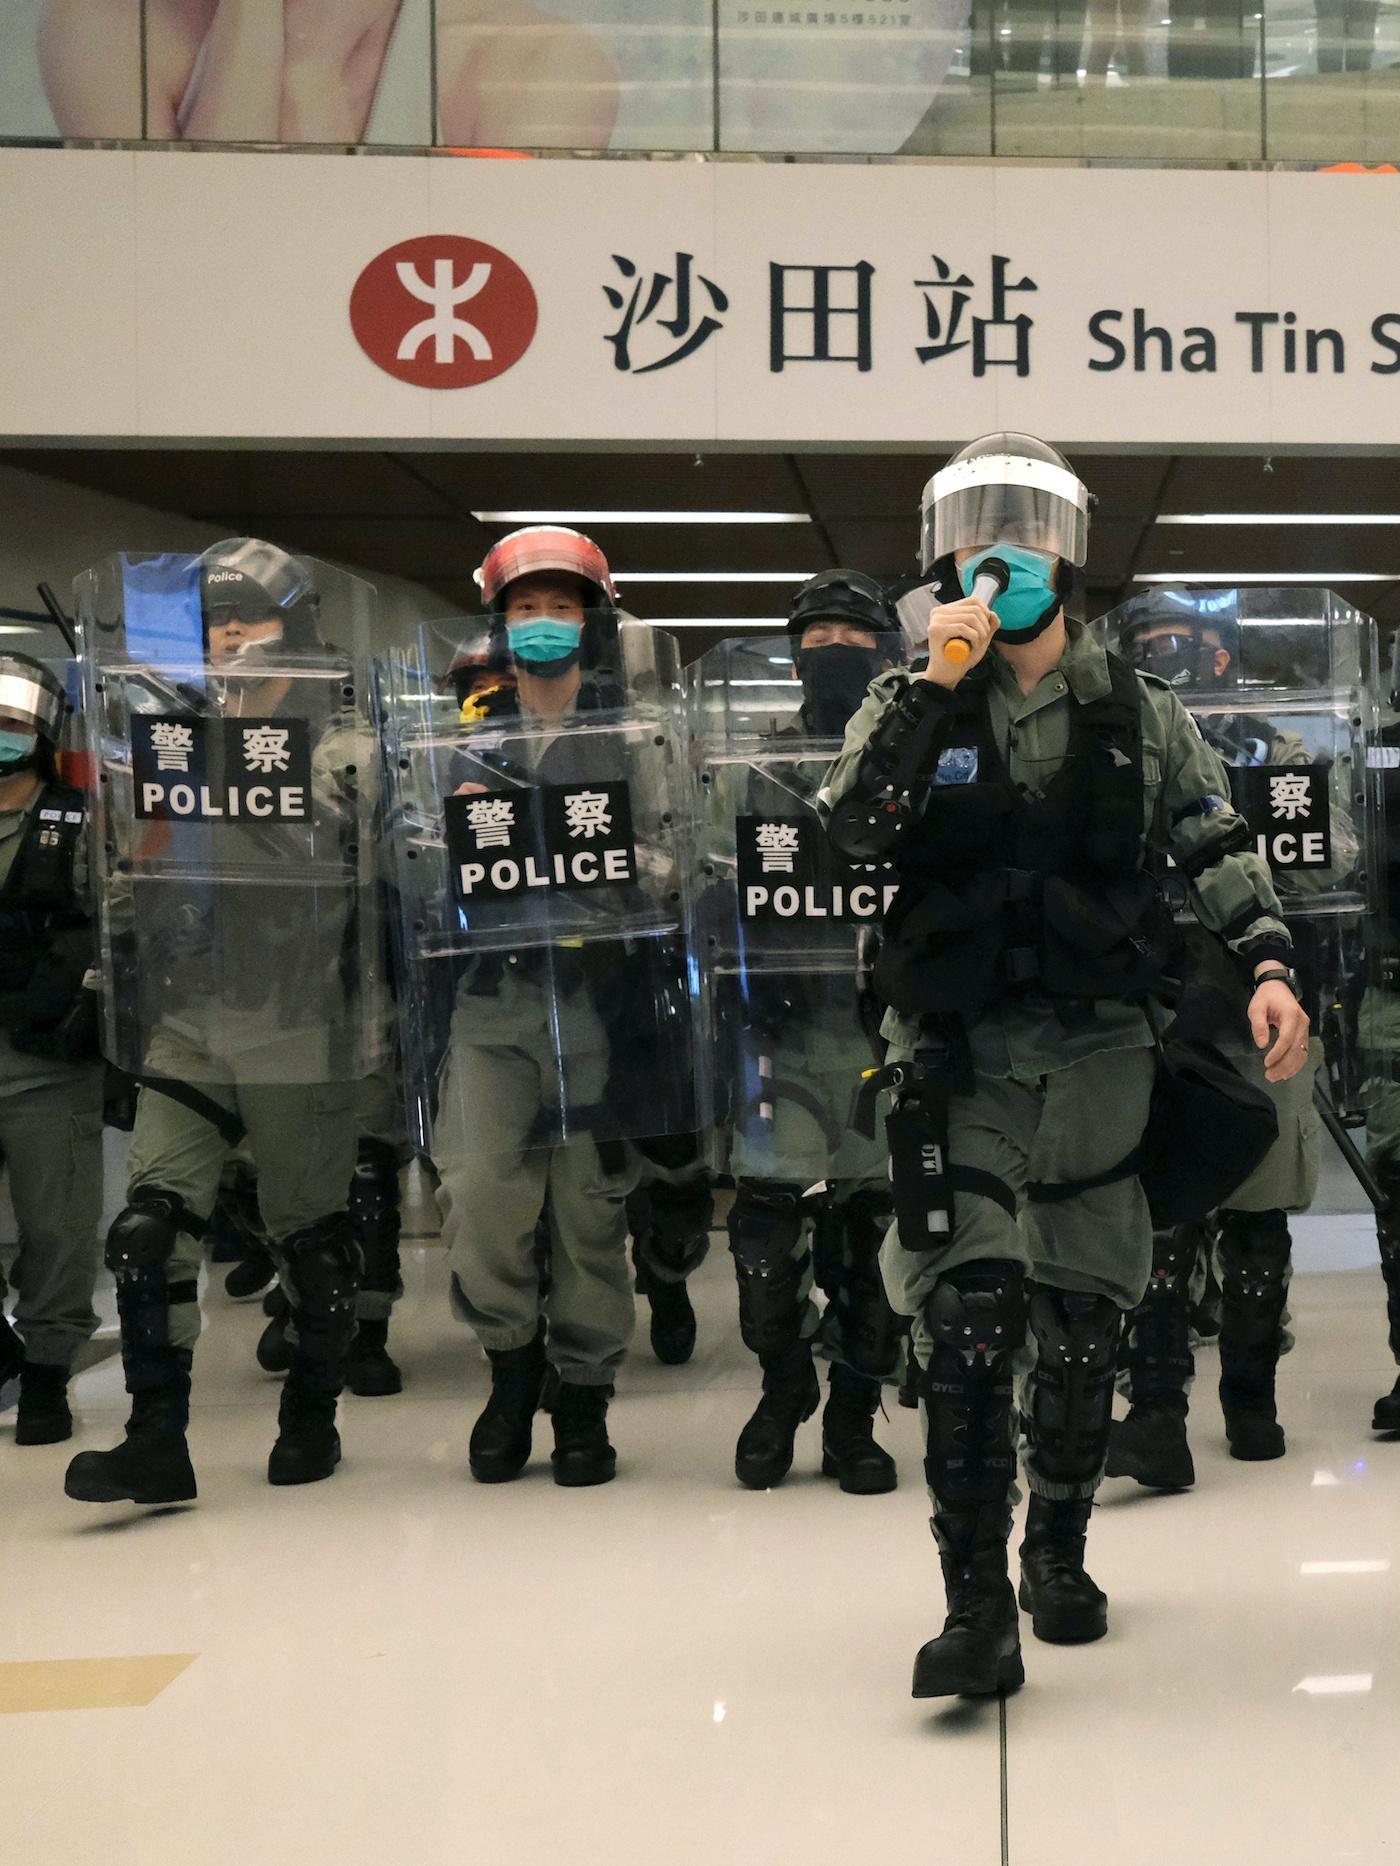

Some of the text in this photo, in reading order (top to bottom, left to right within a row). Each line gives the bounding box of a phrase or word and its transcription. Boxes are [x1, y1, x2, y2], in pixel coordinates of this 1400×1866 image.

[602, 252, 1038, 377] 沙田站
[1088, 308, 1217, 373] Sha
[1235, 311, 1345, 373] Tin
[151, 722, 291, 773] 警察
[142, 783, 305, 816] POLICE
[466, 790, 612, 849] 警察
[1269, 773, 1312, 820] 察
[460, 849, 630, 894] POLICE
